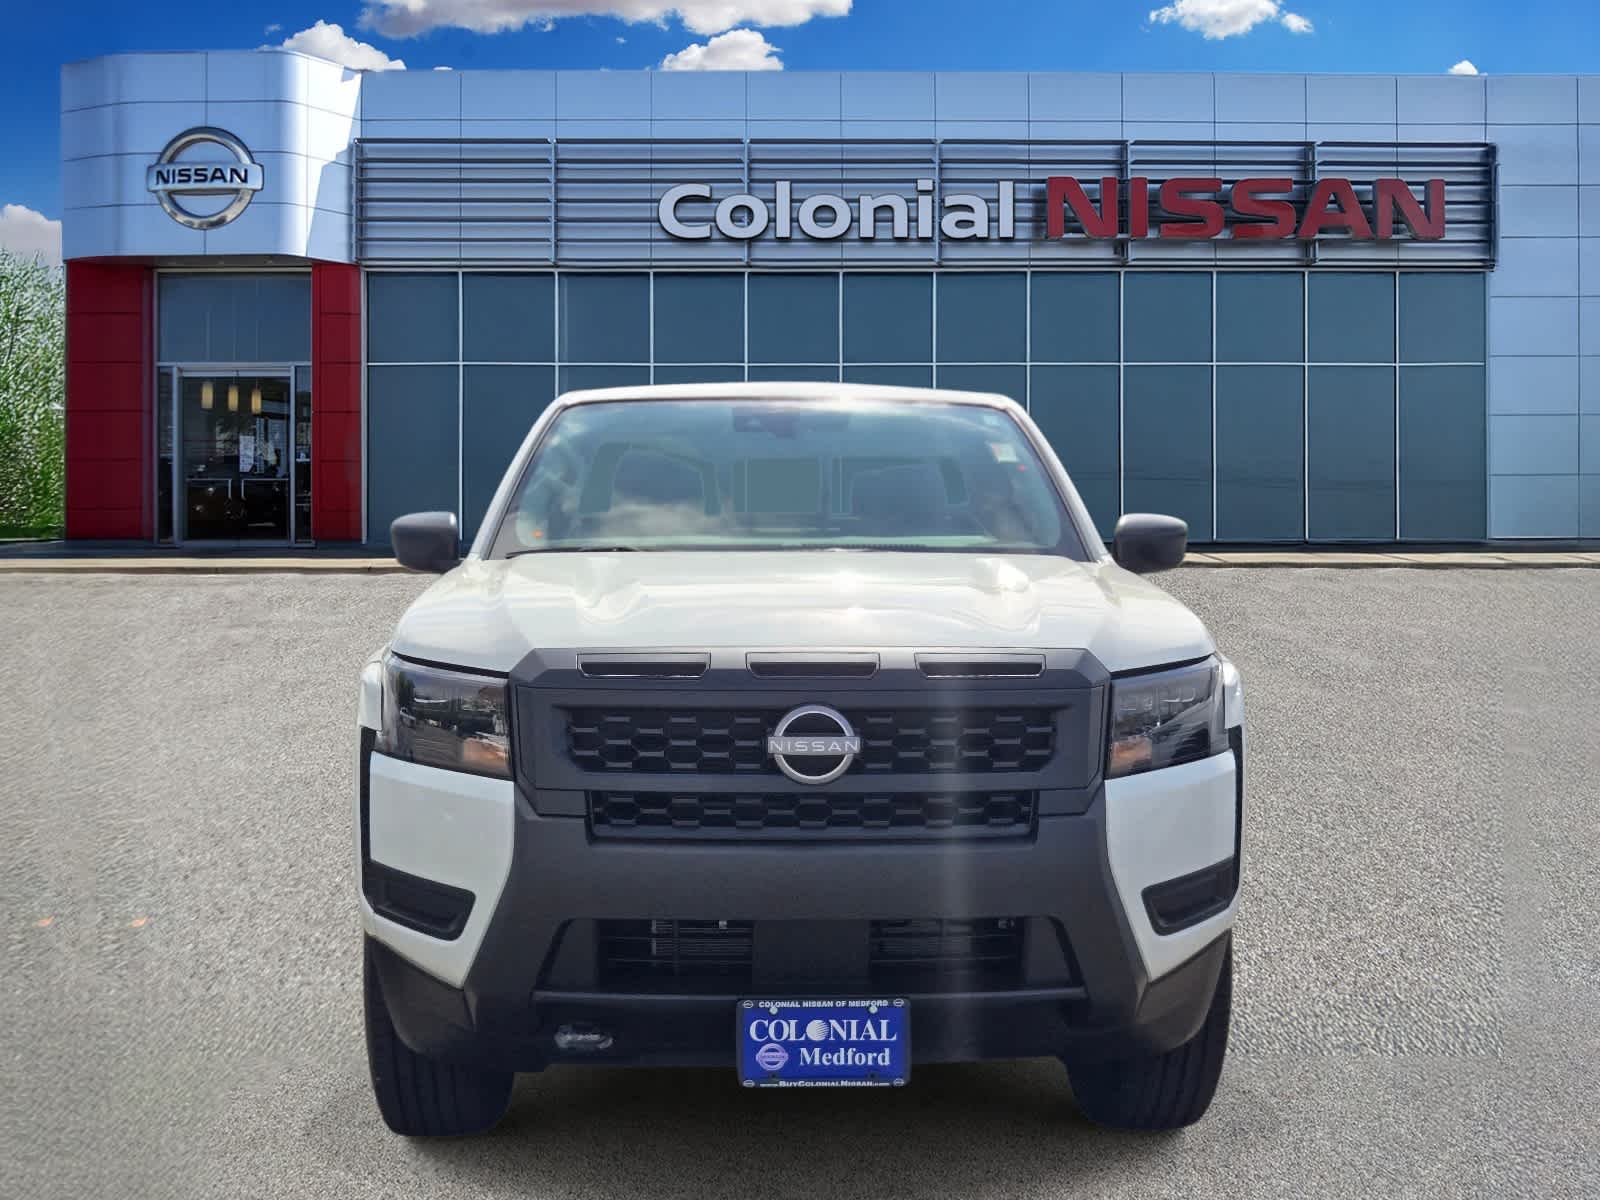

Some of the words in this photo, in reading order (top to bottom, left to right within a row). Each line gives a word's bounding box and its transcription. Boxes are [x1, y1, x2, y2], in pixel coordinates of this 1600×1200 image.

[156, 168, 248, 184] NISSAN
[658, 180, 1014, 240] Colonial
[1047, 176, 1445, 240] NISSAN
[769, 740, 858, 753] NISSAN
[758, 1000, 801, 1008] COLONIAL
[802, 1000, 834, 1008] NISSAN
[835, 1000, 847, 1008] OF
[848, 999, 889, 1007] MEDFORD
[749, 1019, 897, 1041] COLONIAL
[799, 1047, 891, 1066] Medford
